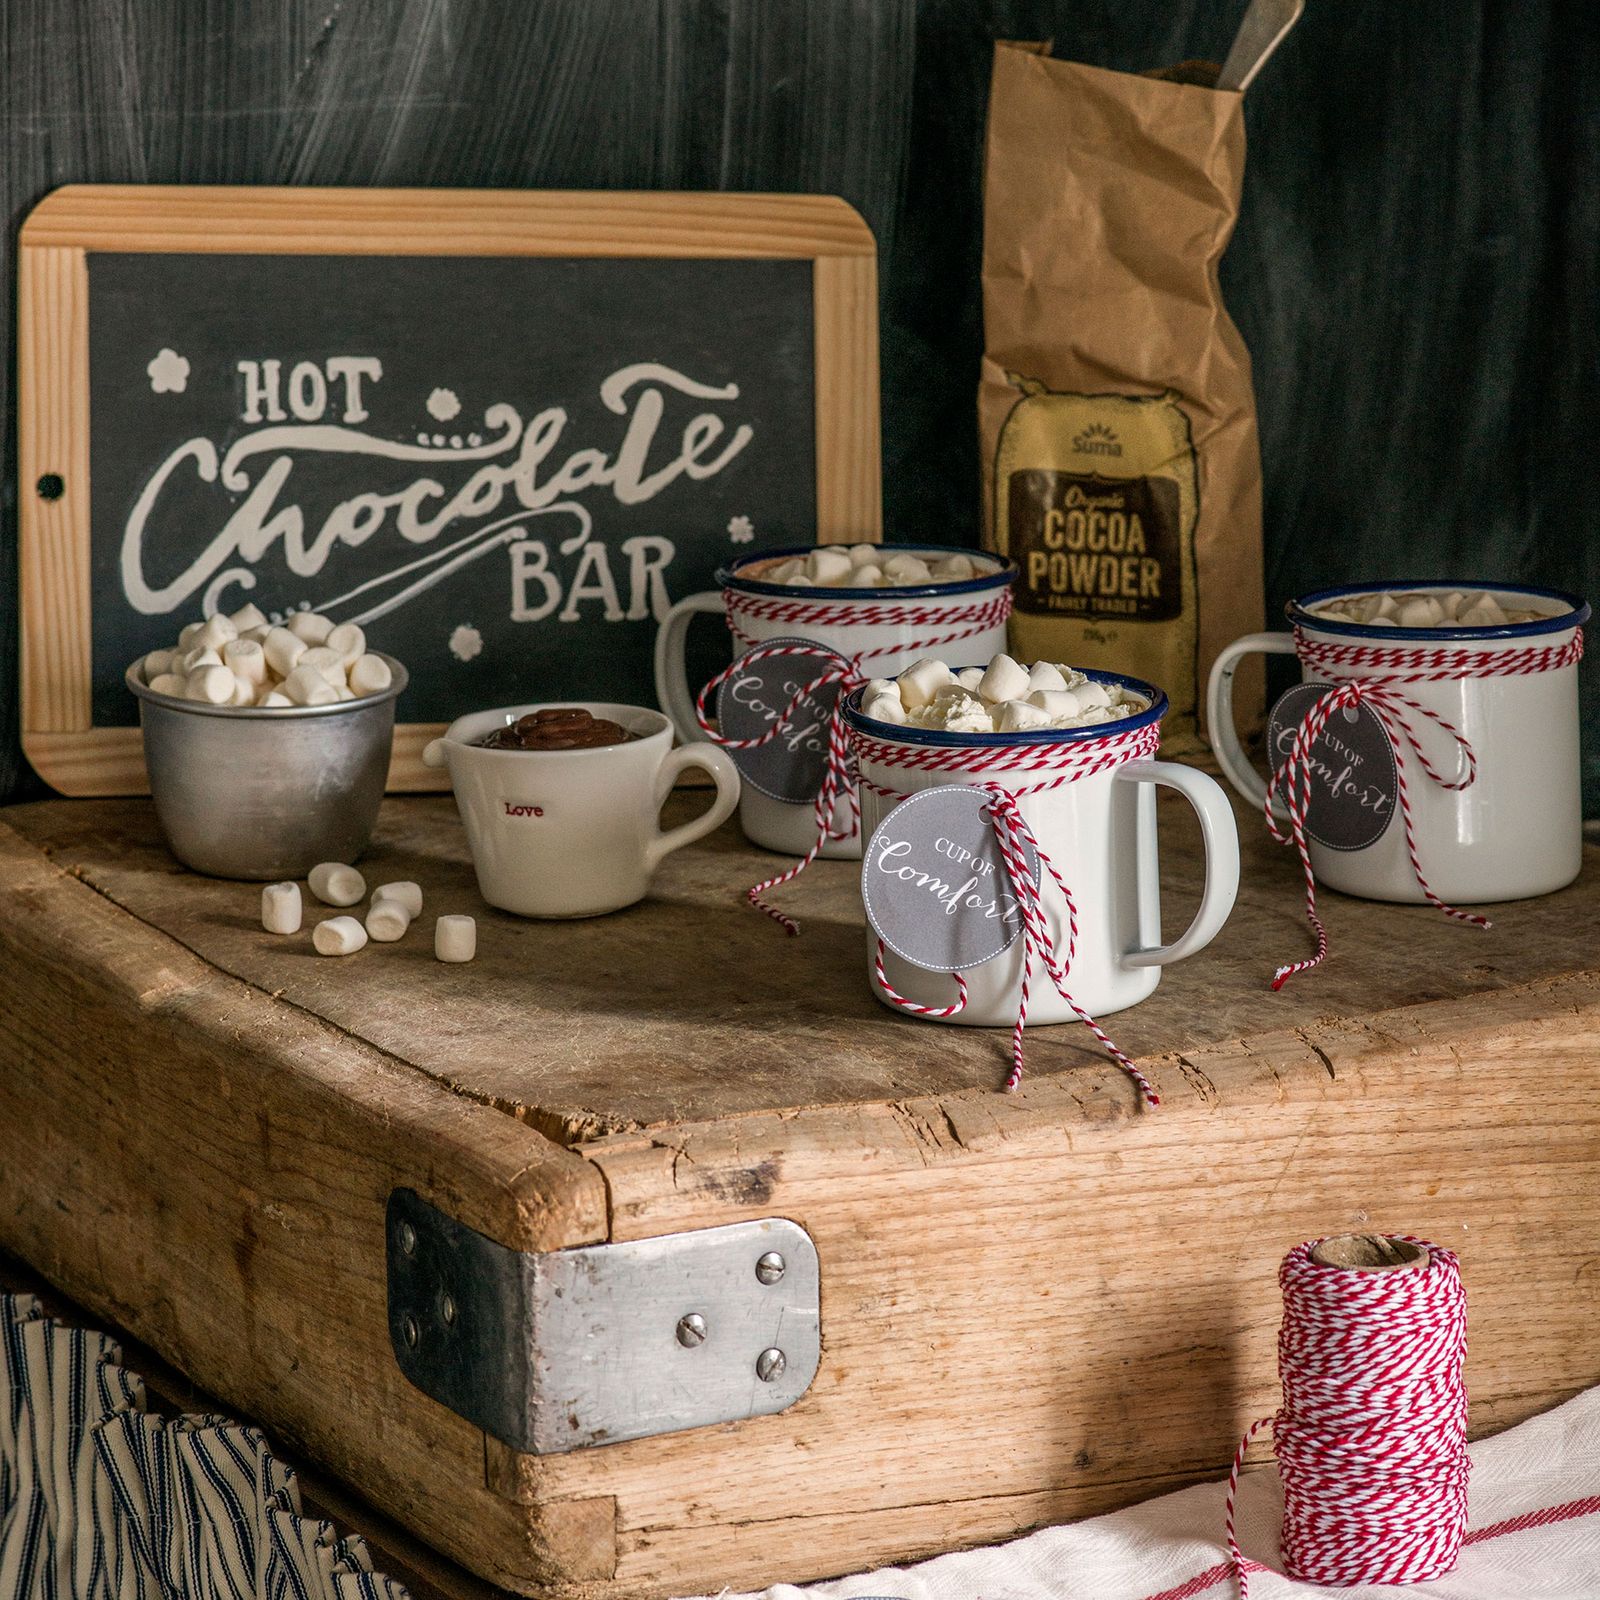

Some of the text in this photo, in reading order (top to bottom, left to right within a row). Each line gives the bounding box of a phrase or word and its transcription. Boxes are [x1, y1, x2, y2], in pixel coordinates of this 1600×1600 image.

[237, 356, 383, 424] HOT
[1072, 435, 1123, 458] Suma
[1044, 509, 1146, 554] COCOA
[508, 535, 676, 625] BAR
[1027, 551, 1163, 598] POWDER
[1344, 747, 1365, 767] OF
[504, 801, 545, 817] Love
[878, 835, 1024, 923] Comfort
[934, 837, 996, 878] CUP OF
